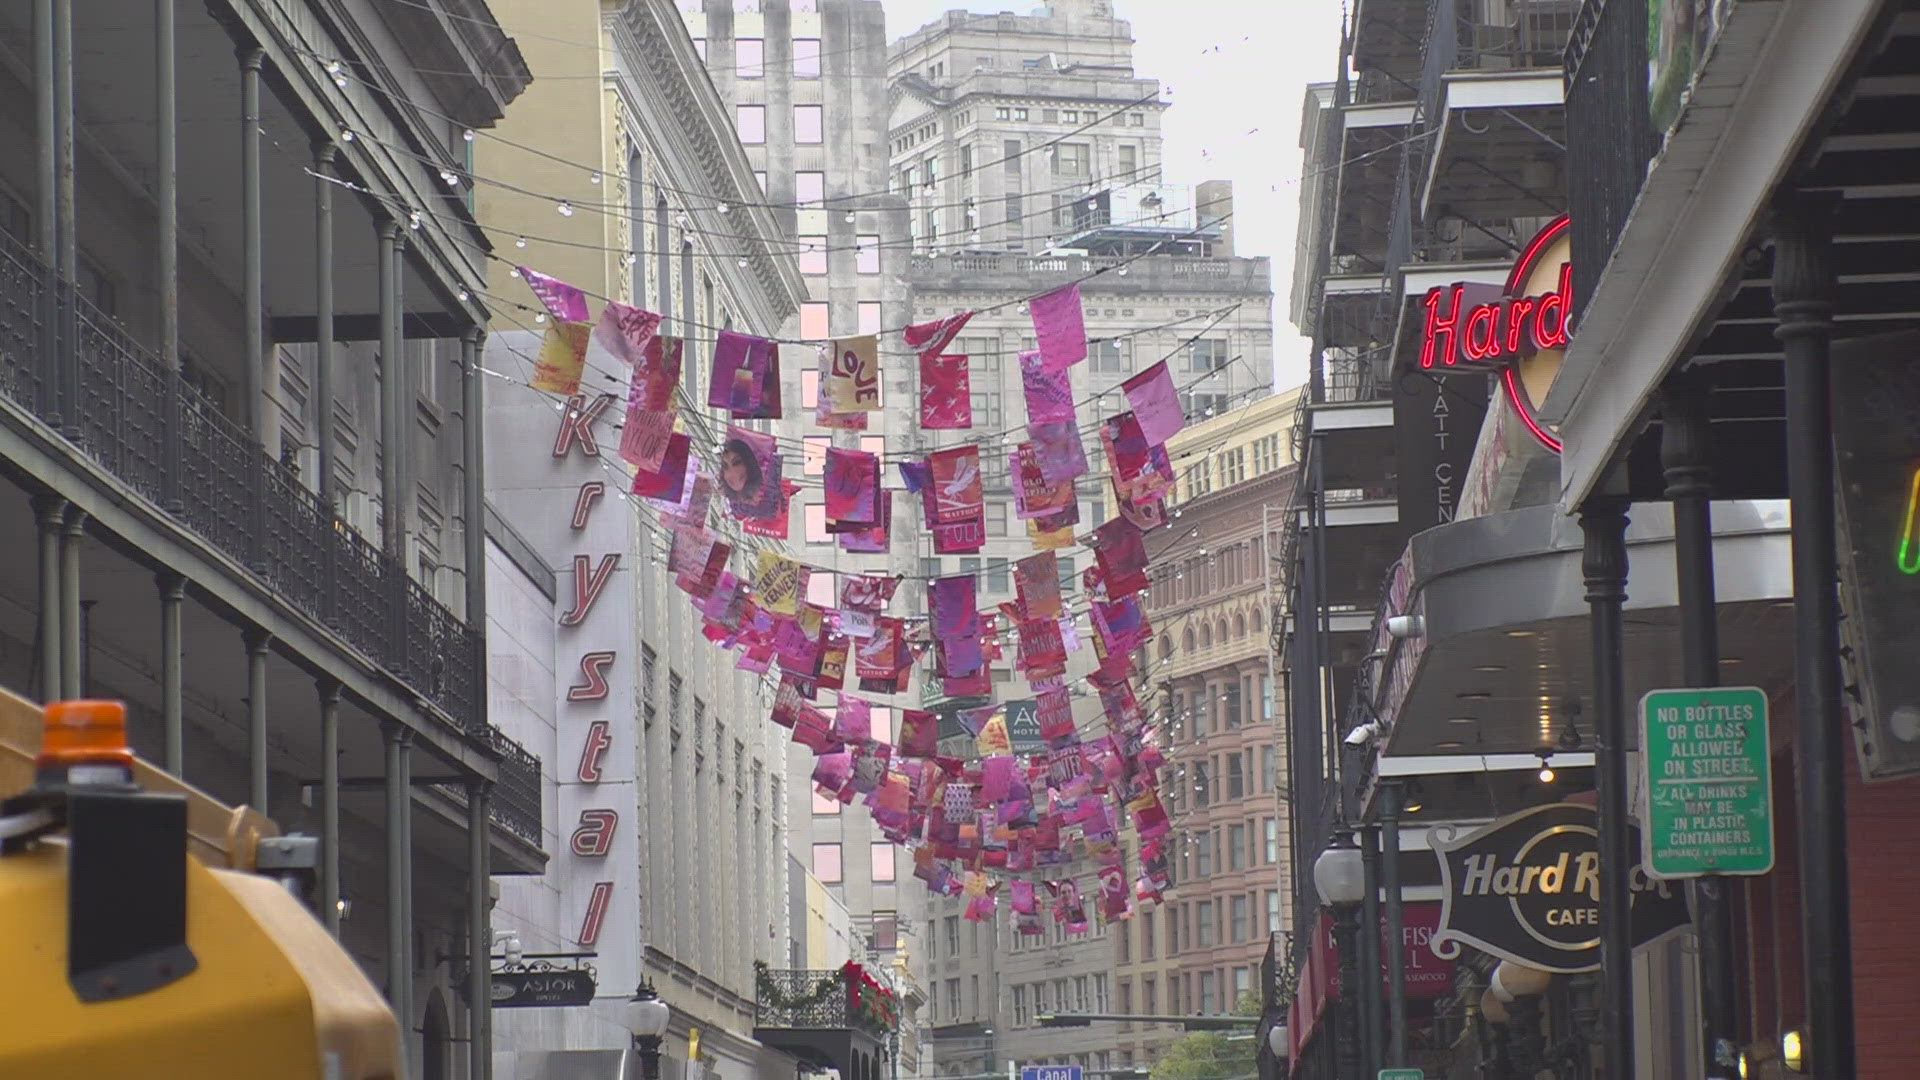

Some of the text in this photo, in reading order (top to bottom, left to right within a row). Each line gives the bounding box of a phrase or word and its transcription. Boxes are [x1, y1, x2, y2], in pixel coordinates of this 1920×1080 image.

[1421, 265, 1573, 369] Hard
[1433, 376, 1449, 450] YATT
[1435, 463, 1452, 522] CEN
[747, 524, 782, 537] MATTHEW
[552, 393, 622, 946] Krystal
[1657, 704, 1754, 722] NO BOTTLES
[1013, 728, 1040, 736] HOTE
[1667, 722, 1747, 740] OR GLASS
[1671, 740, 1743, 757] ALLOWED
[1664, 759, 1685, 775] ON
[1671, 785, 1747, 801] ALL DRINKS
[1685, 801, 1734, 815] MAY BE
[1674, 814, 1746, 831] IN PLASTIC
[1670, 830, 1751, 845] CONTAINERS
[1462, 851, 1673, 902] Hard Rck
[1546, 909, 1598, 926] CAFE
[522, 979, 576, 992] ASTOR
[1037, 1068, 1072, 1080] Canal
